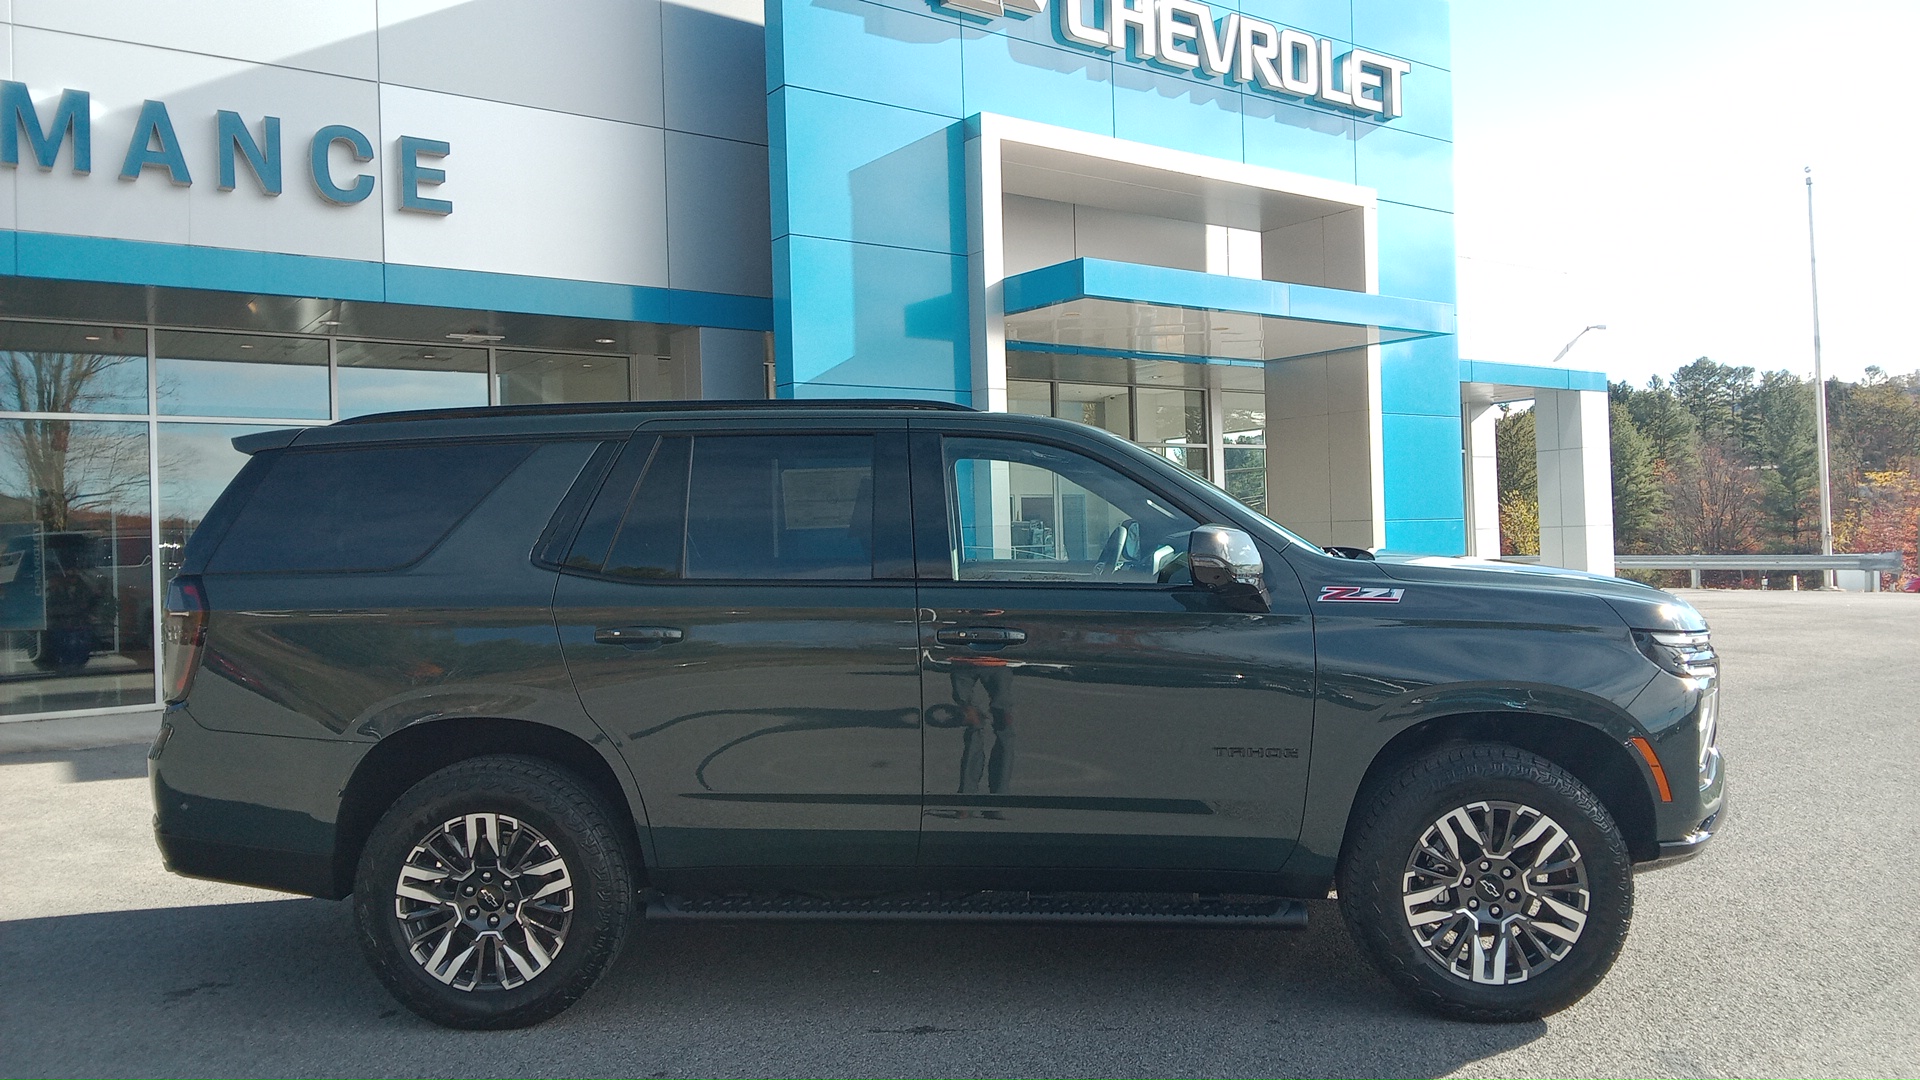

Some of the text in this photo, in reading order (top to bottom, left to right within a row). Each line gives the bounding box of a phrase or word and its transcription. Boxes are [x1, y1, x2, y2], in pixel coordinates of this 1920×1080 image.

[1060, 0, 1411, 120] CHEVROLET
[0, 79, 453, 216] MANCE
[1317, 586, 1405, 603] Z71
[1212, 746, 1299, 759] TAHOE
